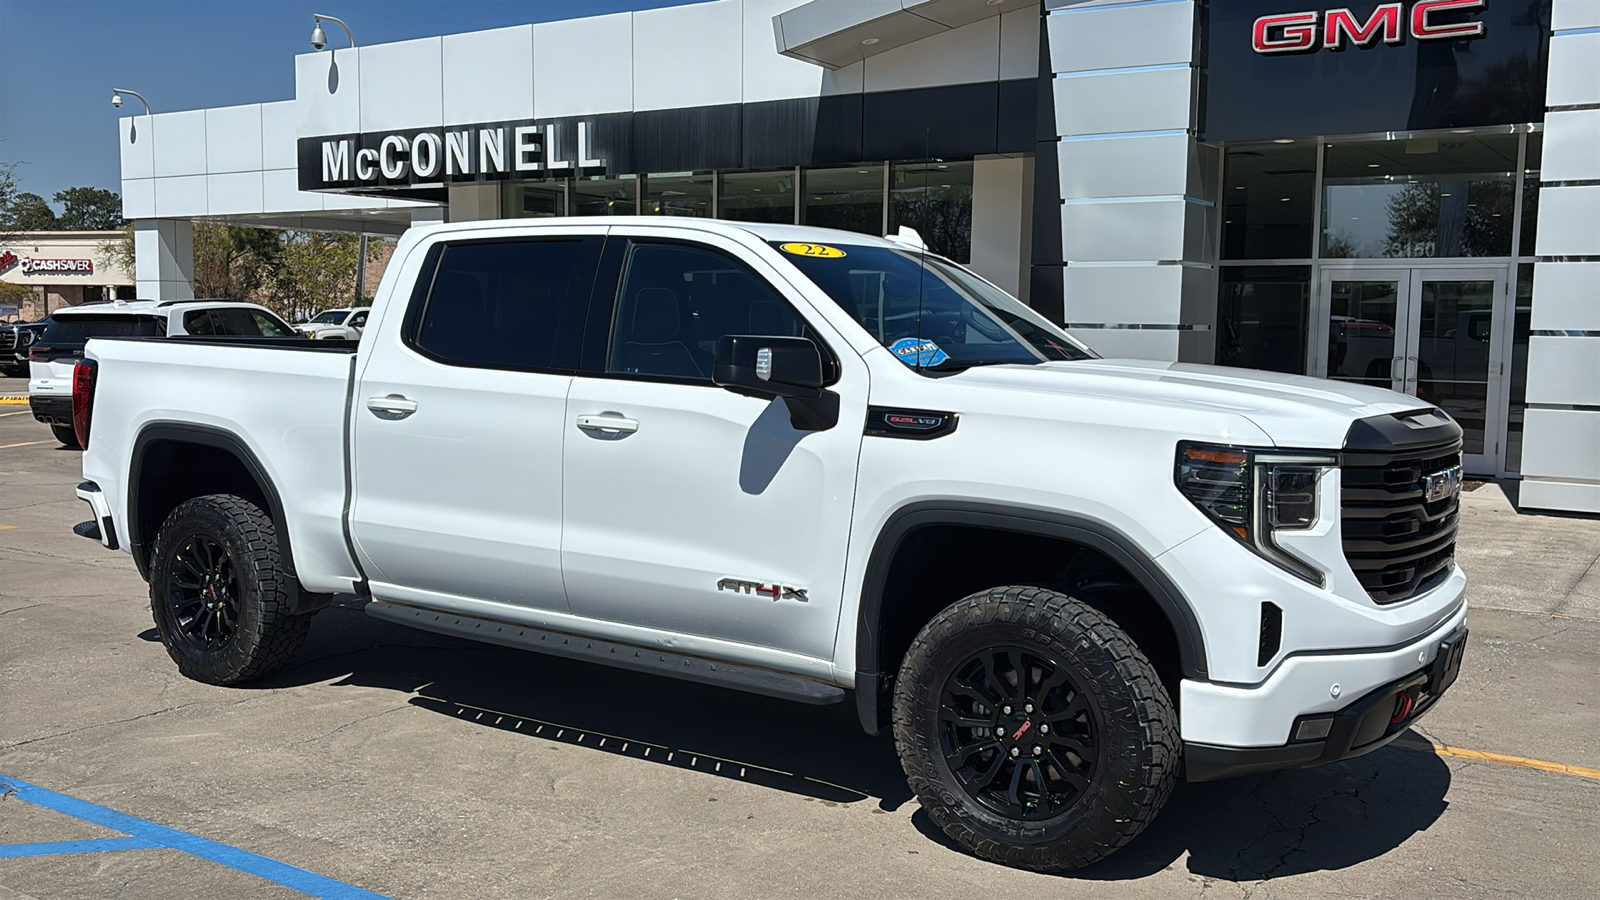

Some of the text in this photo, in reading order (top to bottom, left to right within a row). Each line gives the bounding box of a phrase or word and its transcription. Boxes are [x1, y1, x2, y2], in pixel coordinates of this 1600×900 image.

[1252, 0, 1487, 53] GMC
[321, 121, 607, 183] McCONNELL
[801, 244, 830, 256] 22
[717, 578, 809, 602] AT4X
